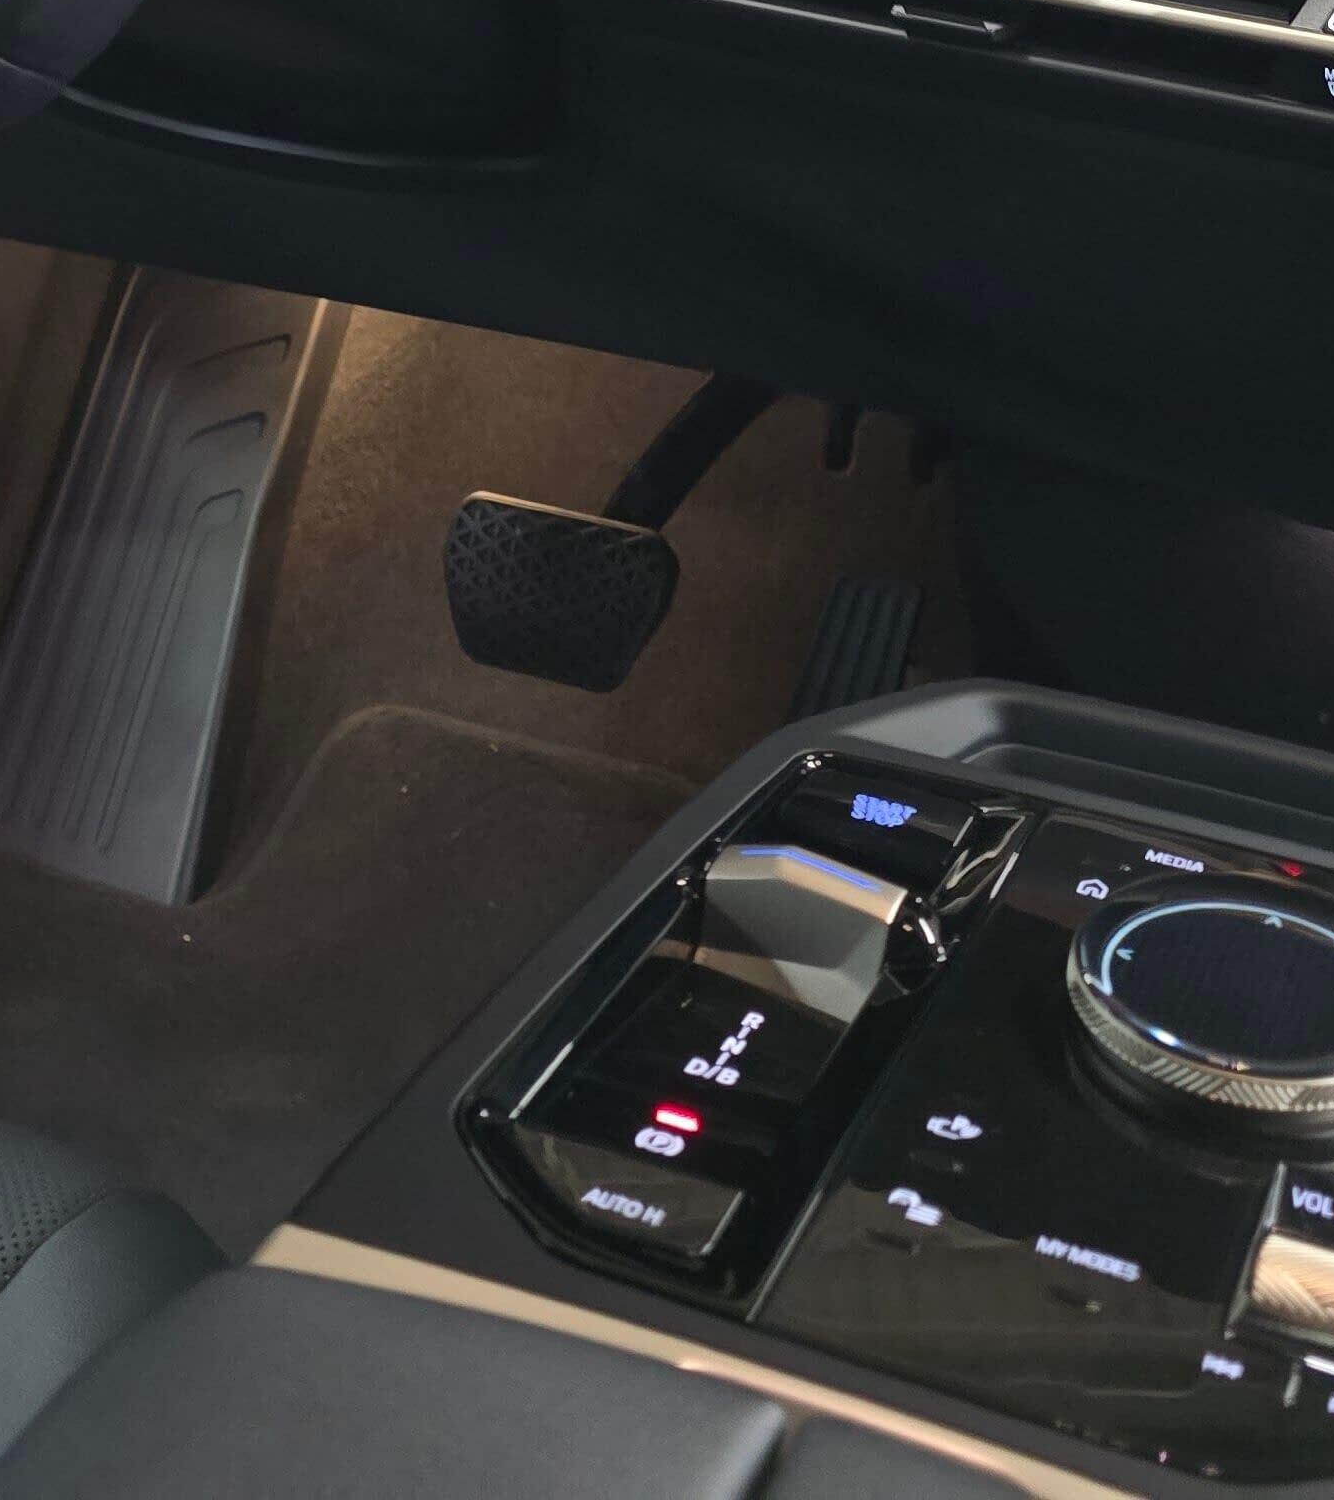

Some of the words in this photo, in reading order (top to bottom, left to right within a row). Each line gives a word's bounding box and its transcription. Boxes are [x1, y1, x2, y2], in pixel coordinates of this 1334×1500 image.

[1144, 848, 1204, 873] MEDIA
[581, 1186, 644, 1219] AUTO
[641, 1204, 666, 1227] H
